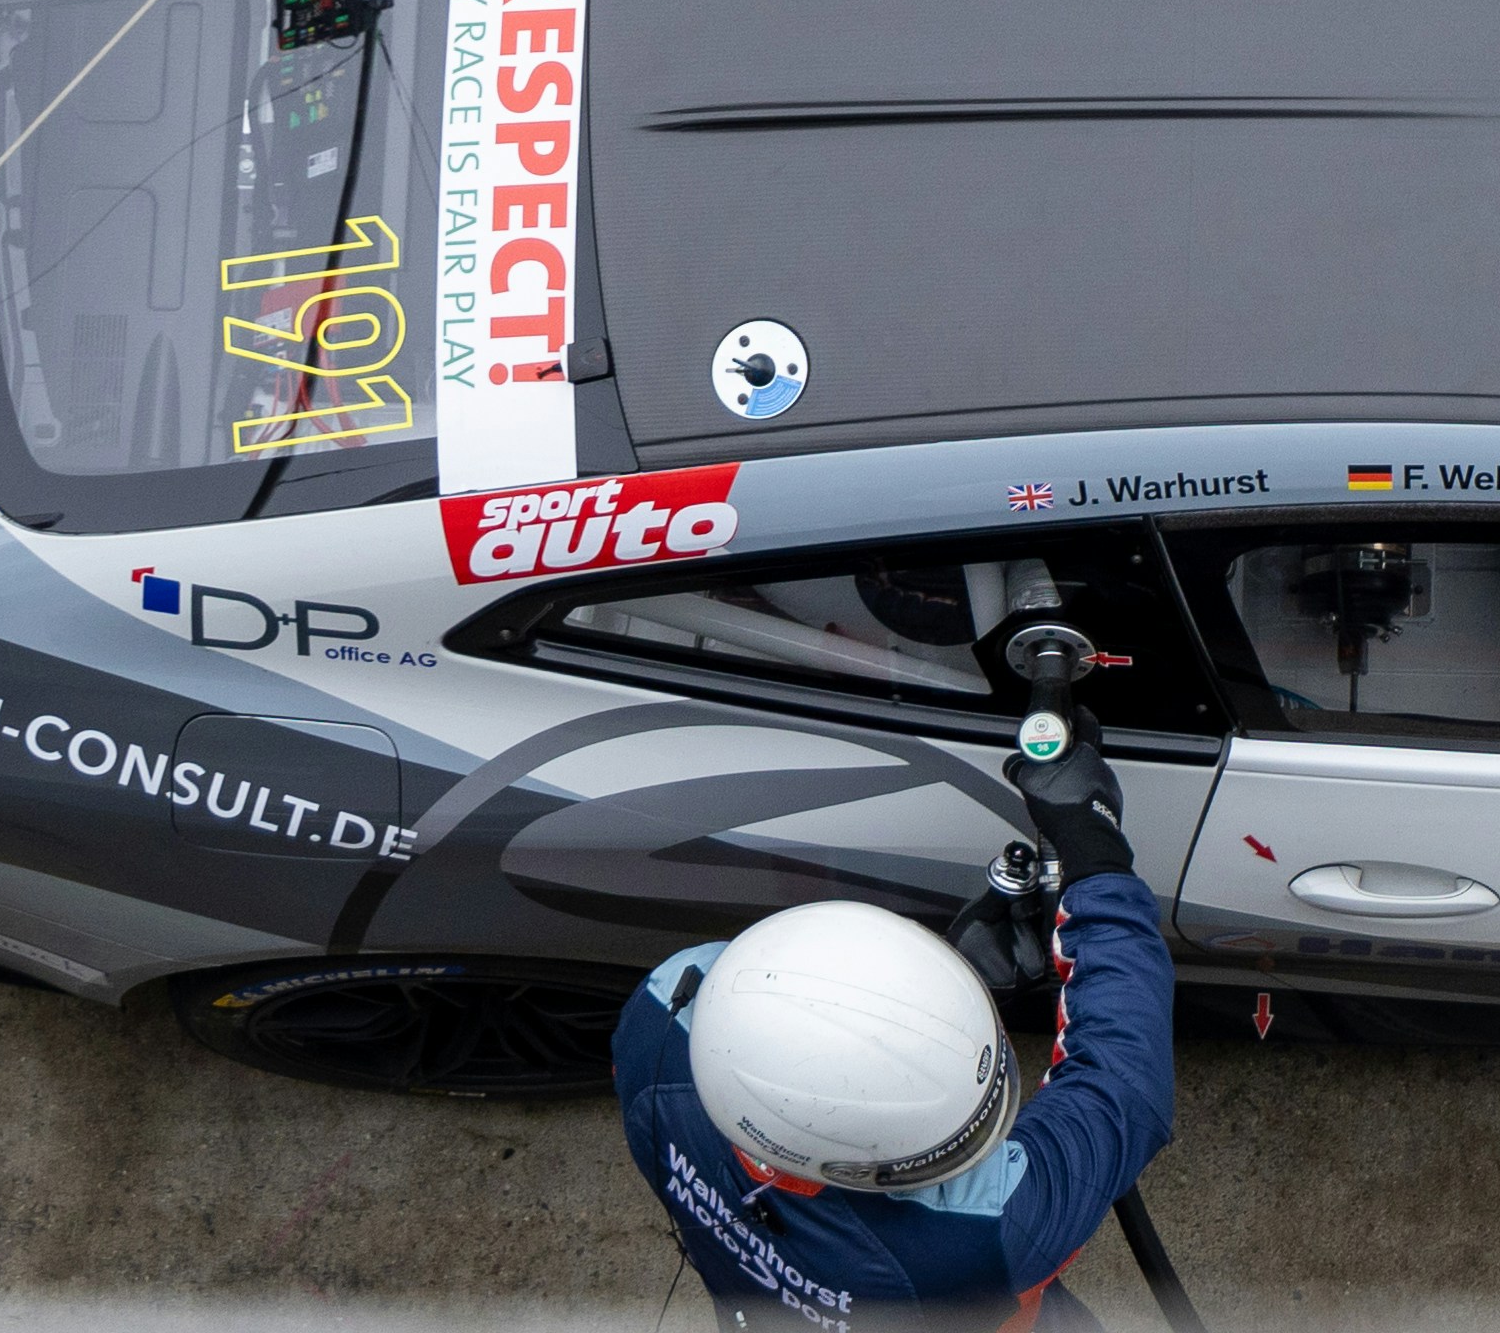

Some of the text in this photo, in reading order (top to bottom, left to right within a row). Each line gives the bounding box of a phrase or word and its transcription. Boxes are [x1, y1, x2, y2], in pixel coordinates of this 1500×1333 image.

[450, 21, 488, 126] RACE
[446, 138, 482, 174] IS
[444, 189, 480, 278] FAIR
[220, 214, 414, 455] 191
[442, 291, 478, 390] PLAY
[479, 477, 625, 530] sport
[1067, 467, 1271, 508] J. Warhurst
[1402, 464, 1431, 491] F.
[467, 498, 741, 579] auto
[324, 645, 439, 669] office AG
[741, 1115, 812, 1163] Walkenhorst
[891, 1076, 1003, 1174] Walkenhorst
[669, 1141, 853, 1314] Walkenhorst
